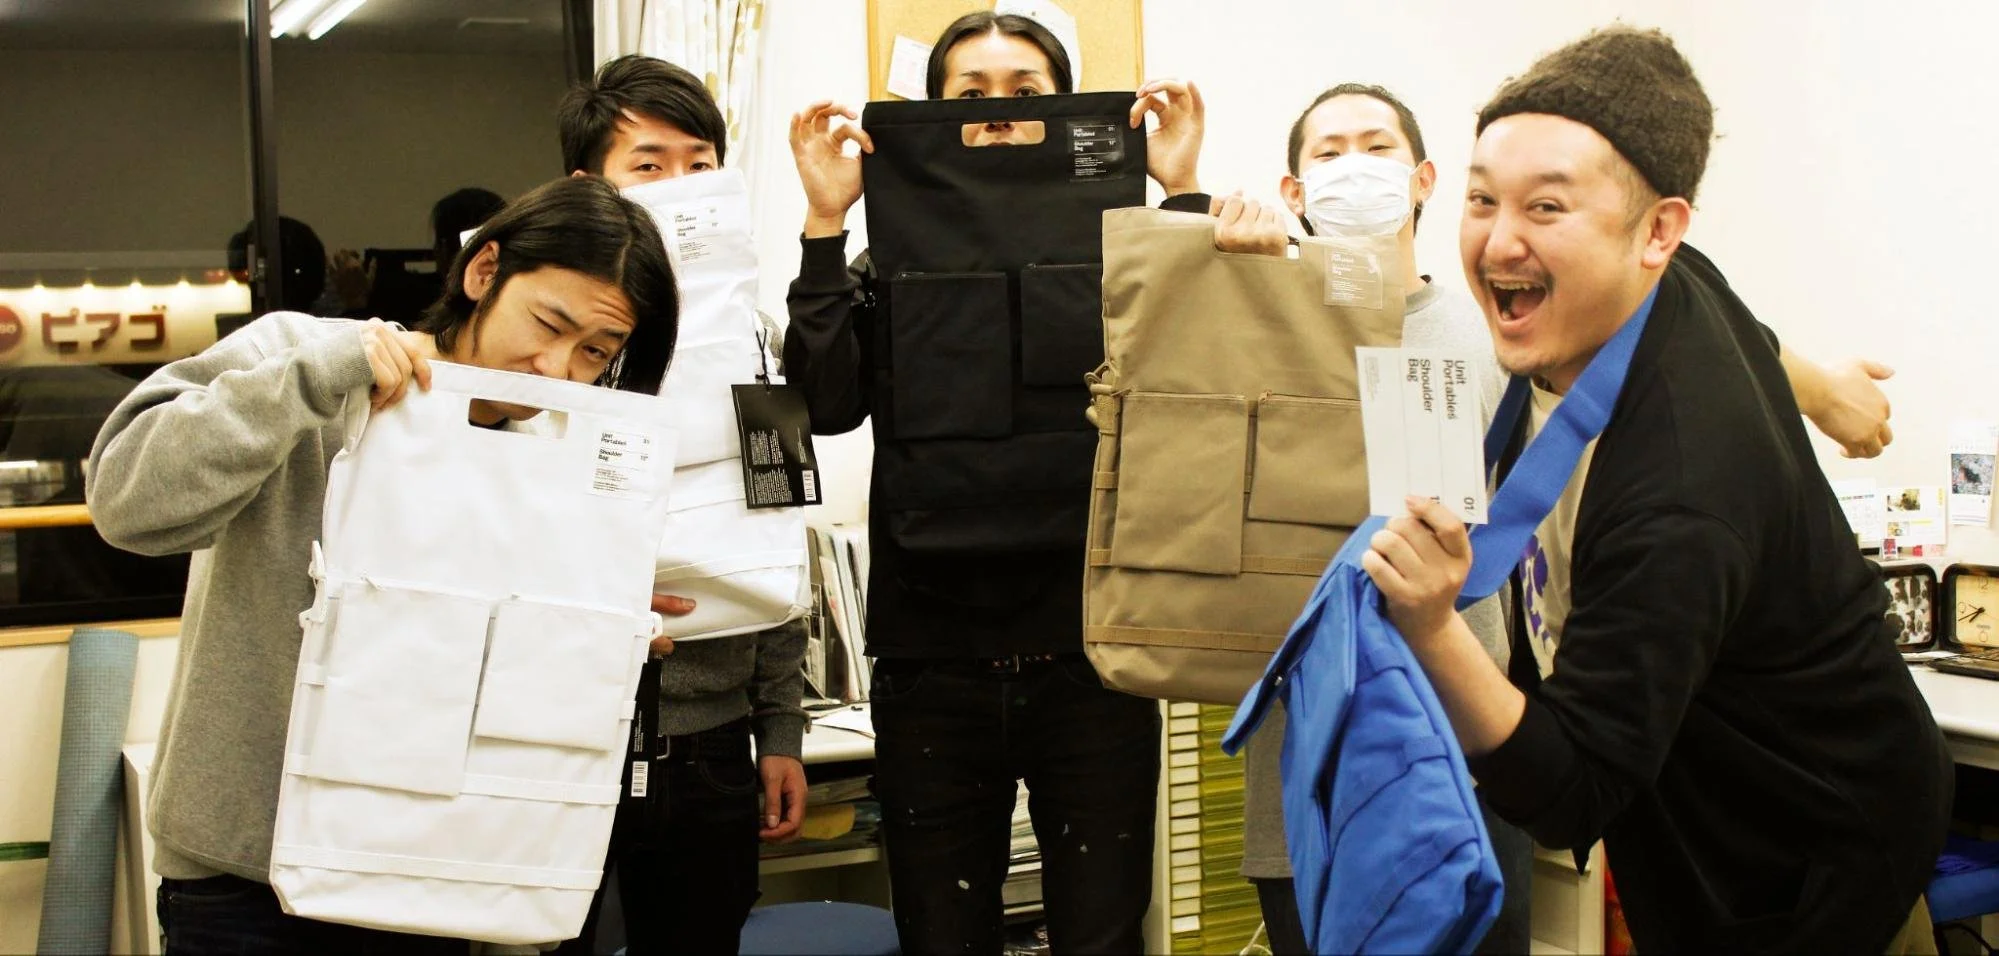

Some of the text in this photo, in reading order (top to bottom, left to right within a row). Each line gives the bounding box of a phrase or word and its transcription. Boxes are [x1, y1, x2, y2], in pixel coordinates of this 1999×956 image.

[41, 303, 167, 354] ピアゴ
[1406, 358, 1419, 383] Bag
[1419, 358, 1435, 413] Shoulder
[1442, 359, 1460, 421] Portables
[1454, 360, 1466, 385] Unit
